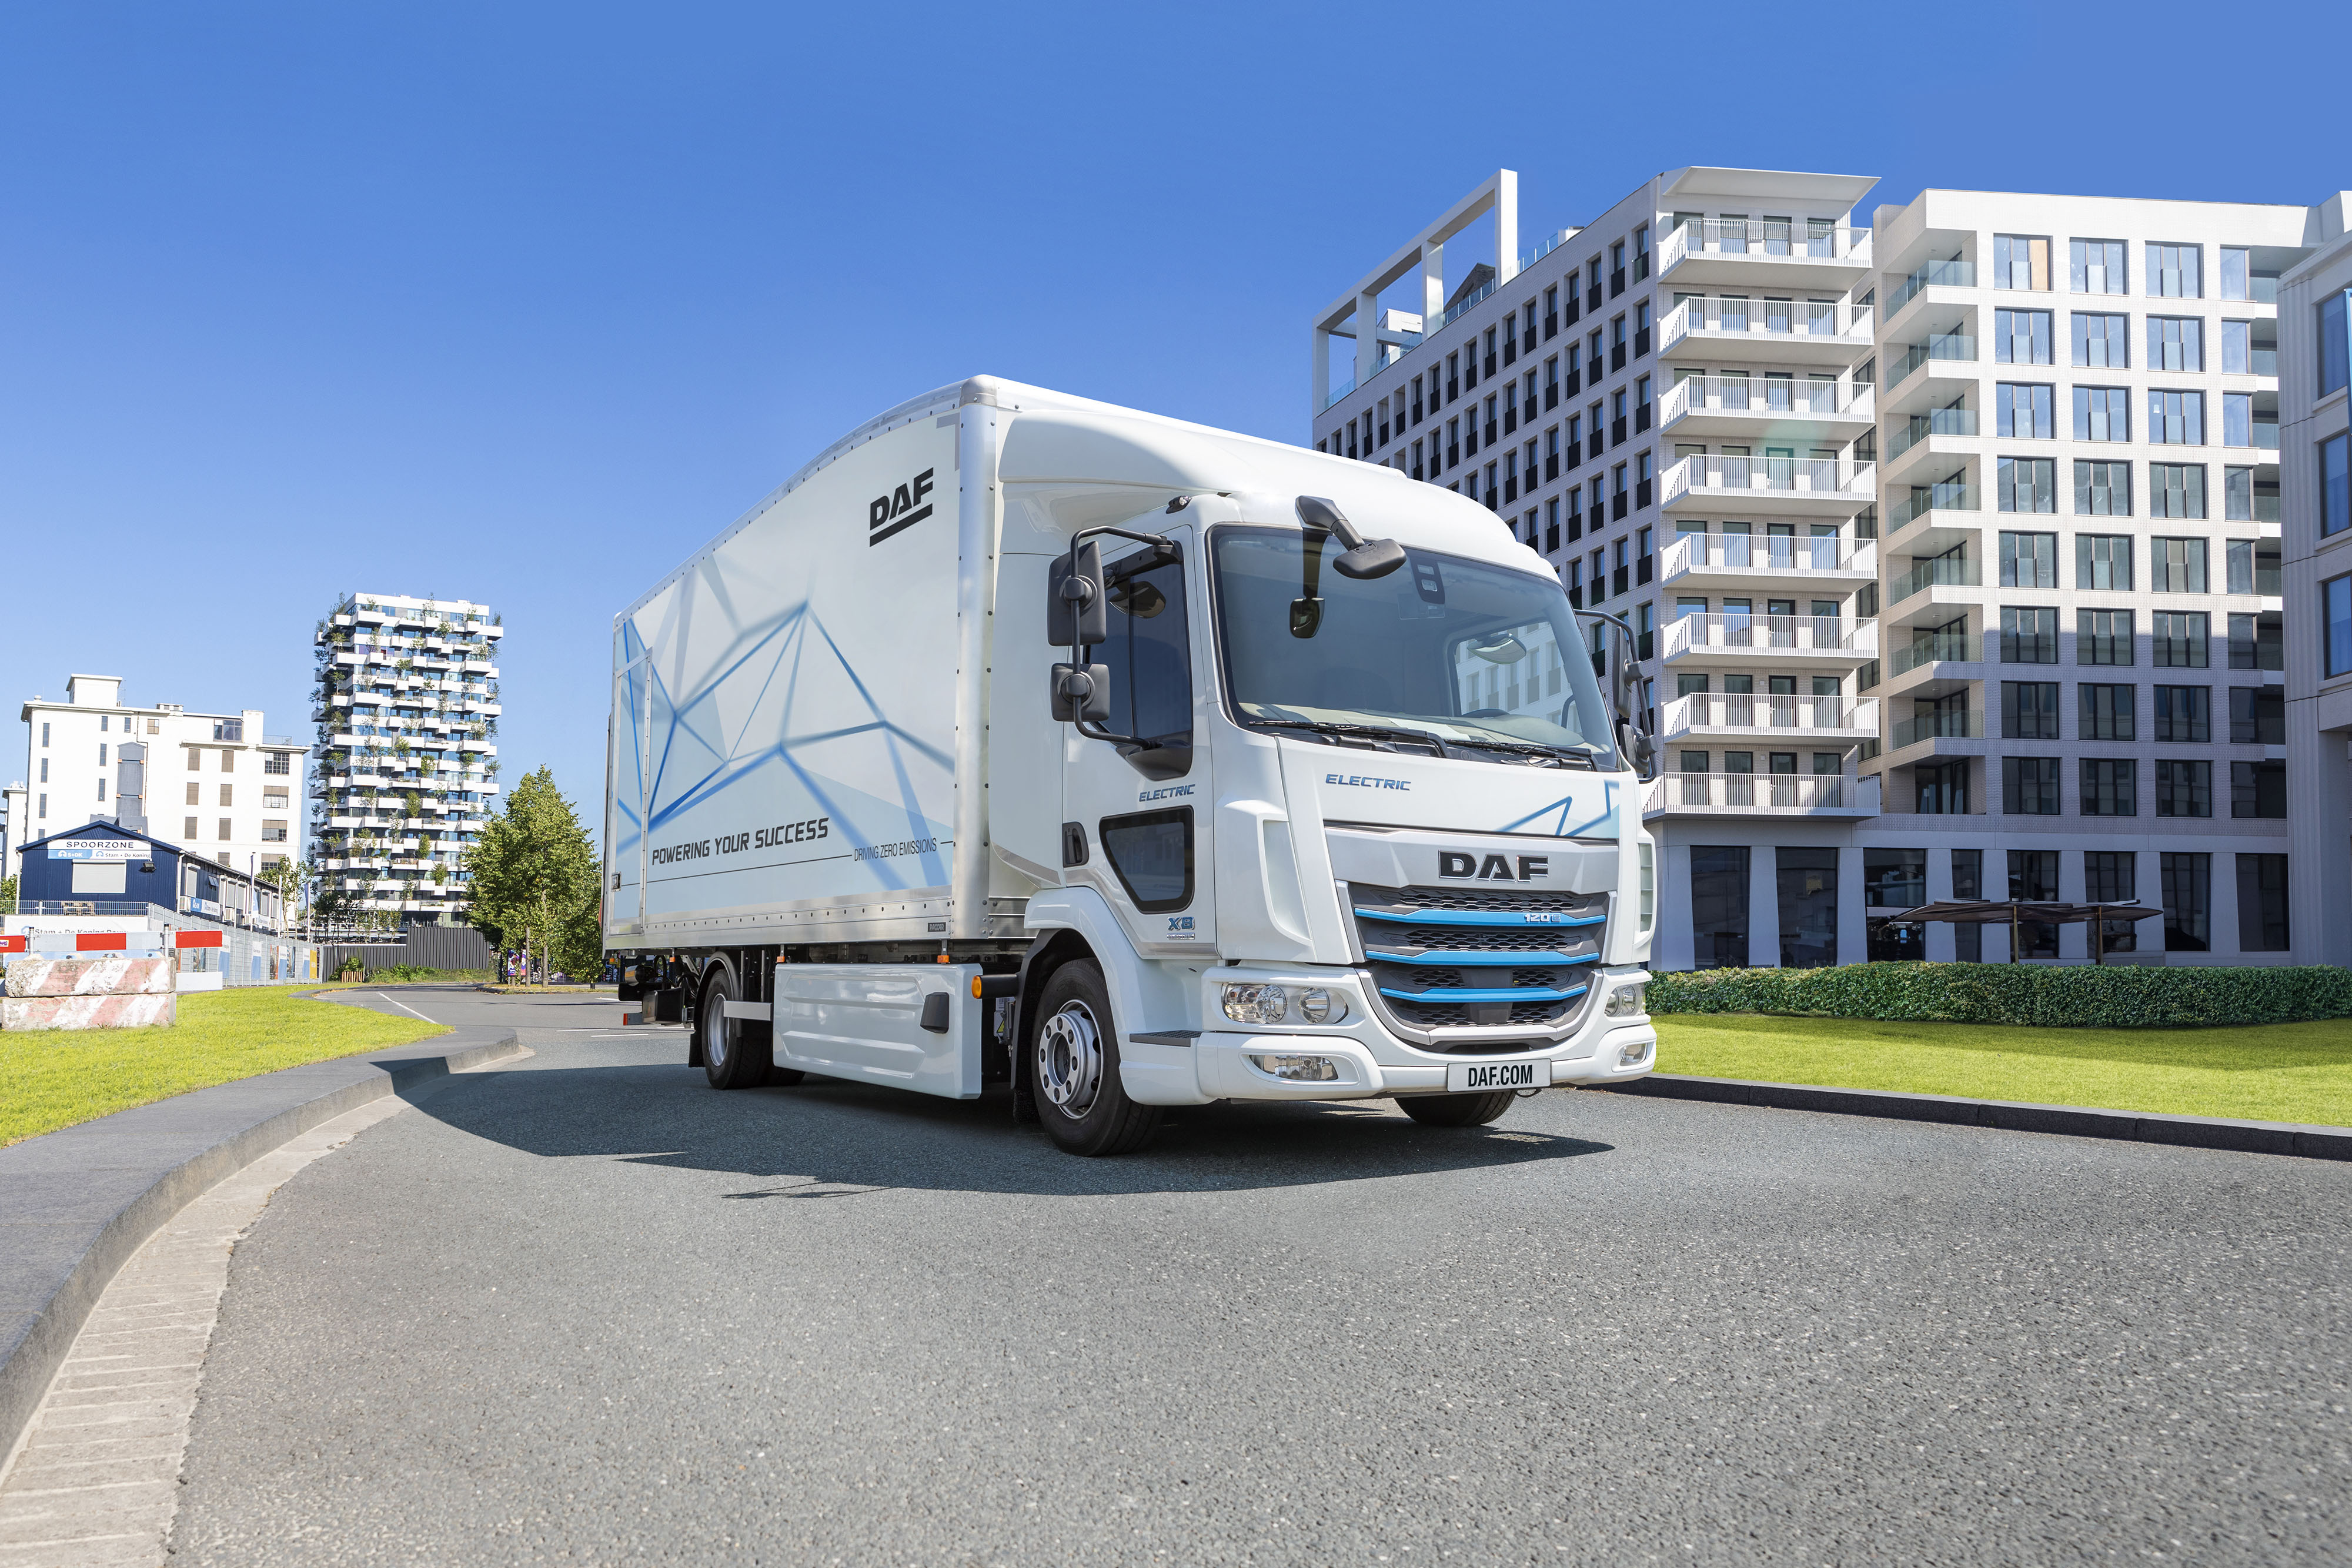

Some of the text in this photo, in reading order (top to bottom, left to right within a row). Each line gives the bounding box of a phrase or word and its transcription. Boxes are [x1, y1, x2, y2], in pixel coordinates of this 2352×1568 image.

[870, 467, 934, 531] DAF
[1139, 784, 1195, 802] ELECTRIC
[1325, 774, 1412, 791] ELECTRIC
[652, 817, 830, 865] POWERING YOUR SUCCESS
[854, 837, 937, 861] DRIVING ZERO EMISSIONS
[1438, 850, 1549, 882] DAF
[1468, 1064, 1532, 1086] DAF.COM
